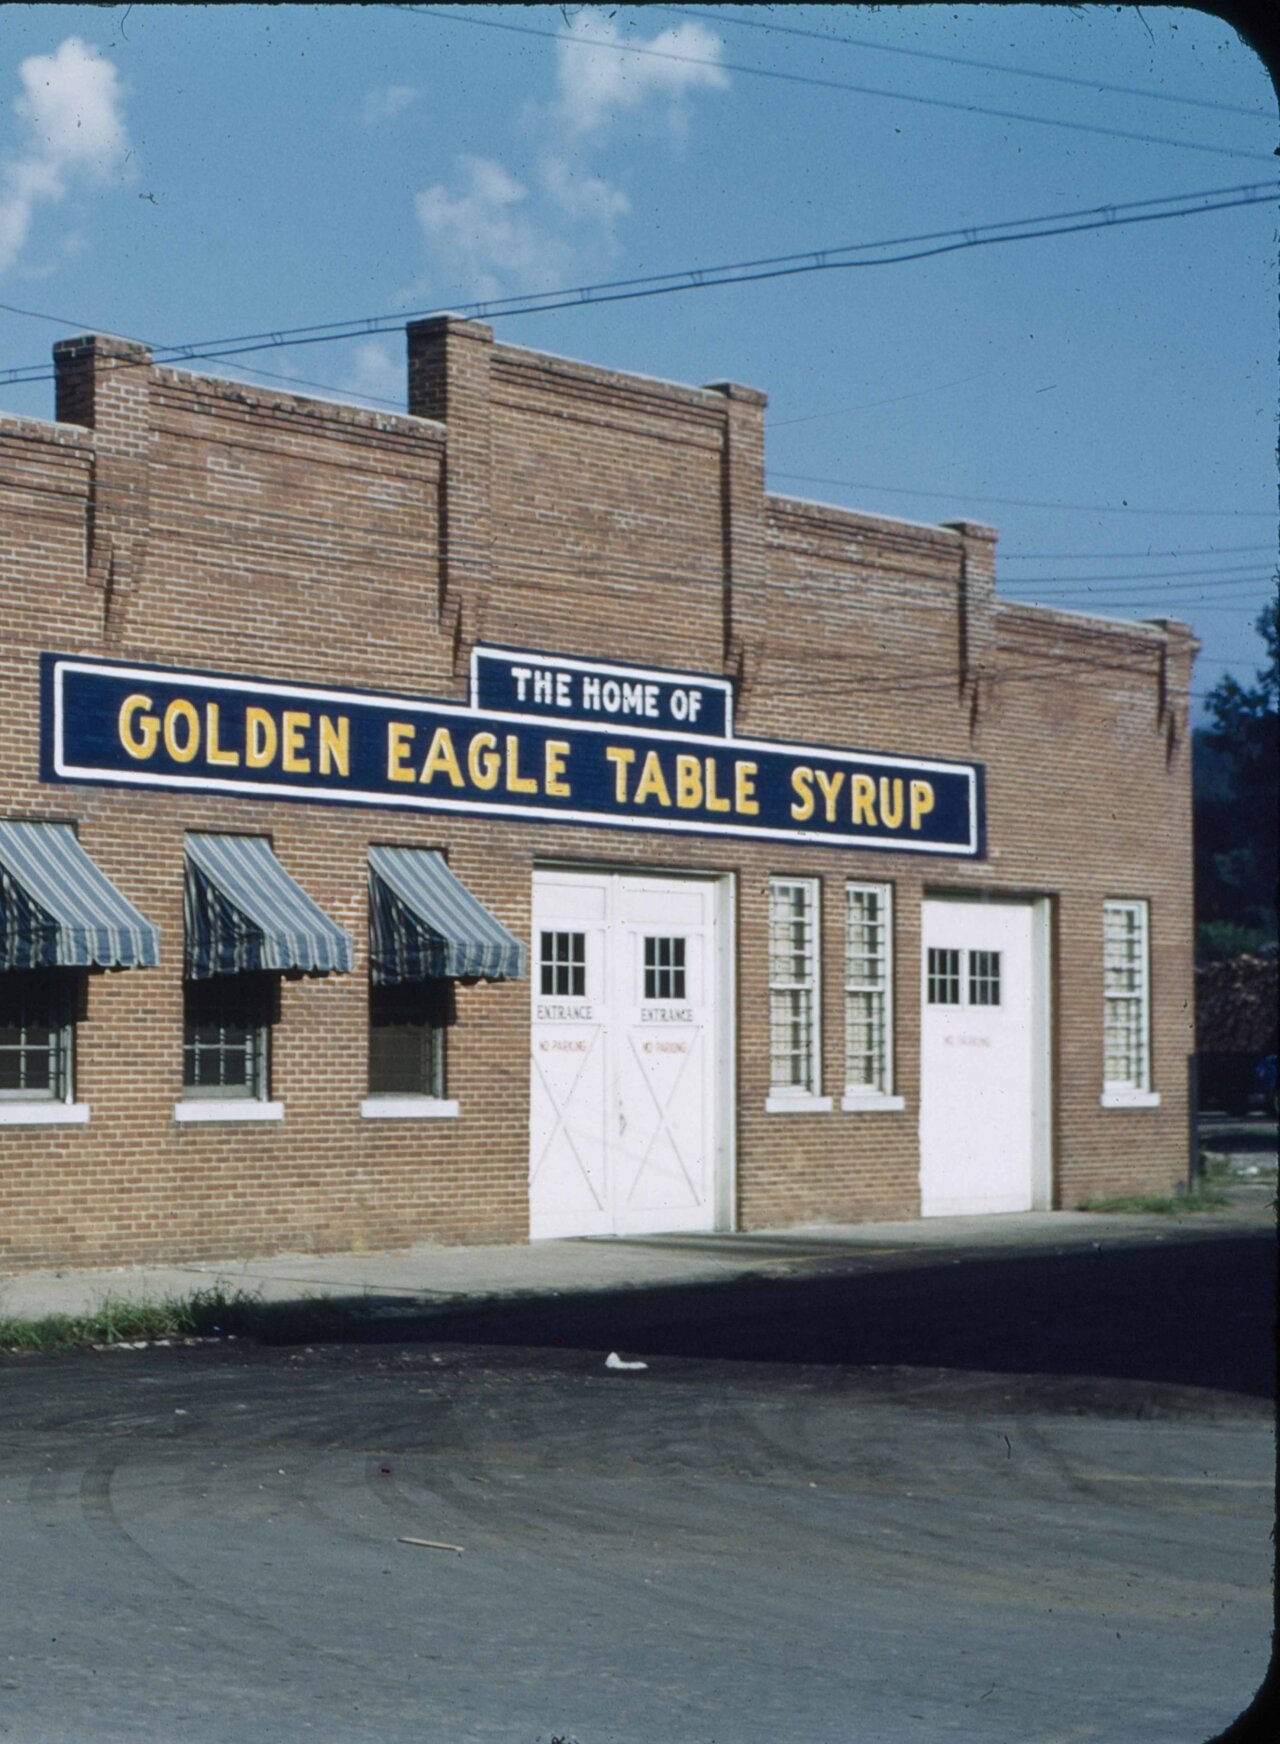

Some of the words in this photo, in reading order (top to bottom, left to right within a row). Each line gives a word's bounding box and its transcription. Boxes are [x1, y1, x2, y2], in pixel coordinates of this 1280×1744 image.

[511, 667, 572, 707] THE
[582, 676, 659, 718] HOME
[670, 689, 703, 722] OF
[118, 694, 350, 777] GOLDEN
[387, 721, 571, 797] EAGLE
[606, 746, 760, 815] TABLE
[790, 765, 936, 830] SYRUP
[537, 1005, 593, 1020] ENTRANCE
[641, 1008, 694, 1023] ENTRANCE
[538, 1040, 549, 1052] NO
[552, 1040, 587, 1053] PARKING
